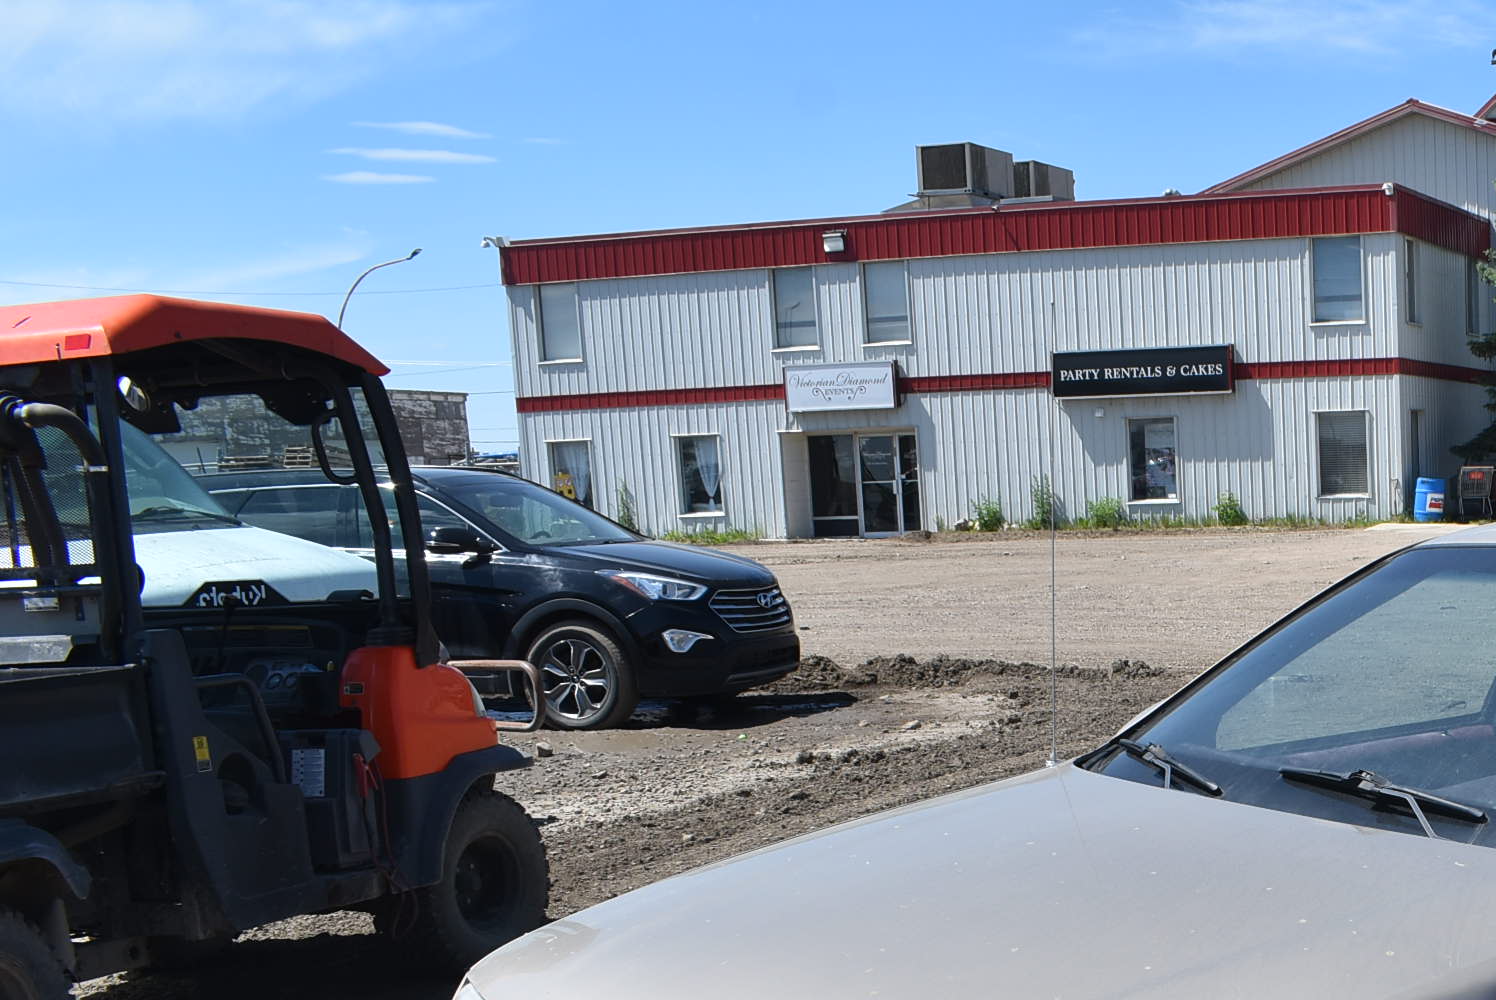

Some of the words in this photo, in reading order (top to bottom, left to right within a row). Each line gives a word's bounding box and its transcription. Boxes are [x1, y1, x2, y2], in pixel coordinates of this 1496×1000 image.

[789, 373, 835, 388] Victorian
[836, 371, 888, 387] Diamond
[1060, 368, 1100, 382] PARTY
[1104, 365, 1162, 380] RENTALS
[1166, 365, 1176, 377] &
[1180, 363, 1223, 377] CAKES
[825, 388, 855, 396] EVENTS
